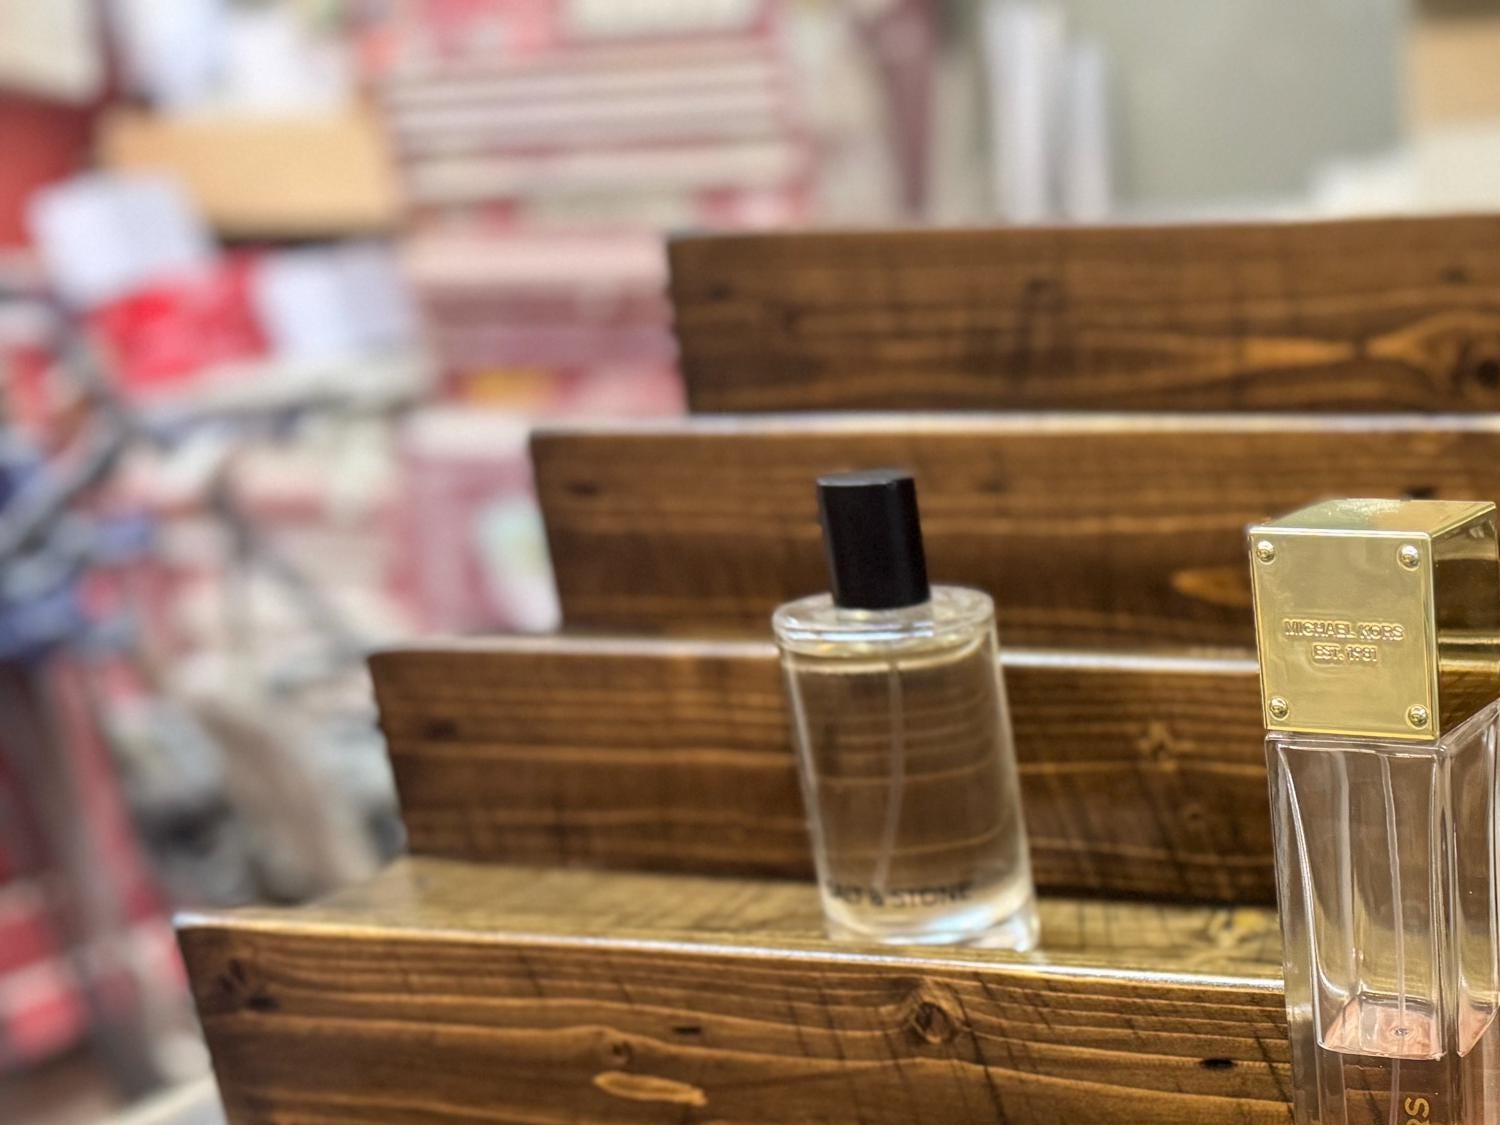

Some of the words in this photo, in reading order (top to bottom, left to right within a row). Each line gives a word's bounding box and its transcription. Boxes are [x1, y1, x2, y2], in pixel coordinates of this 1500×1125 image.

[1284, 619, 1356, 639] MICHAEL
[1358, 622, 1405, 641] KORS
[1312, 643, 1344, 662] EST.
[1346, 645, 1378, 662] 1981
